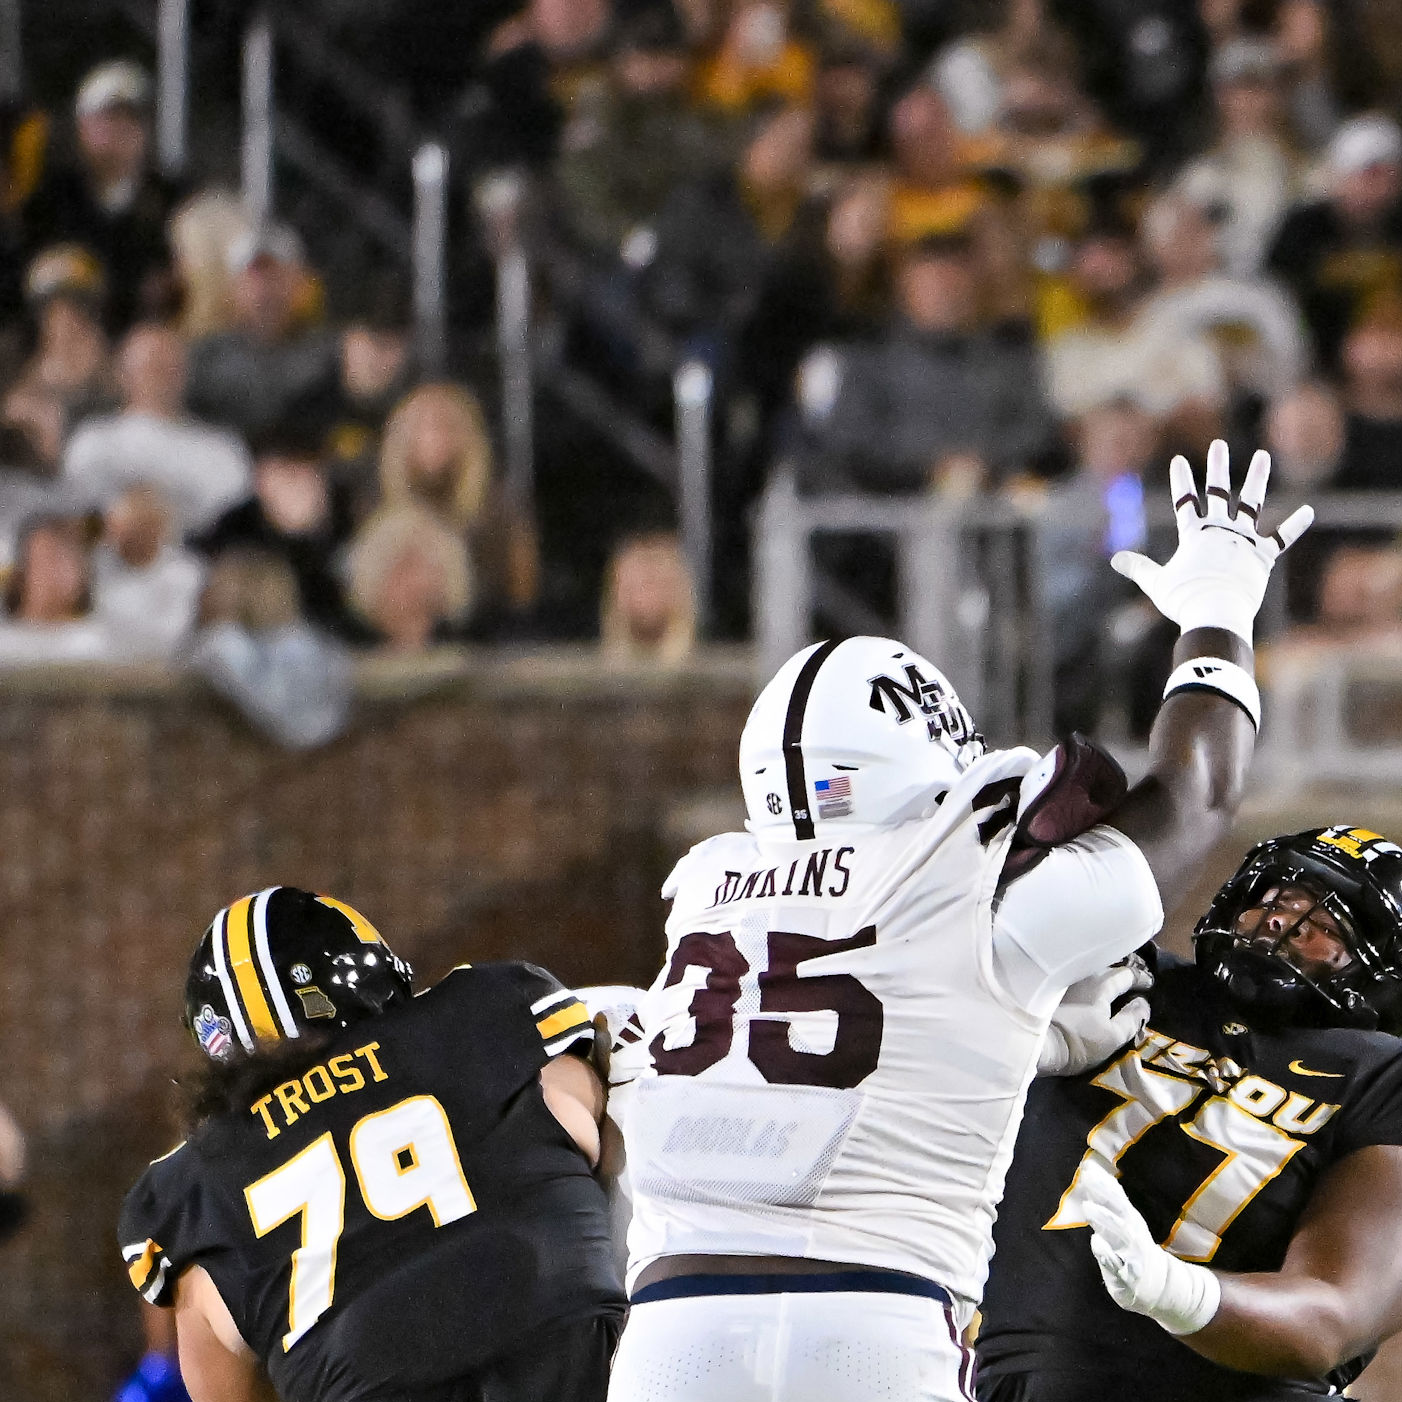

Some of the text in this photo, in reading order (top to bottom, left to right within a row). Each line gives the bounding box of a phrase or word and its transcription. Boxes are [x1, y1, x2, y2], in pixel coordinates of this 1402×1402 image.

[649, 923, 884, 1090] 35
[250, 1041, 390, 1141] TROST
[243, 1094, 478, 1354] 79
